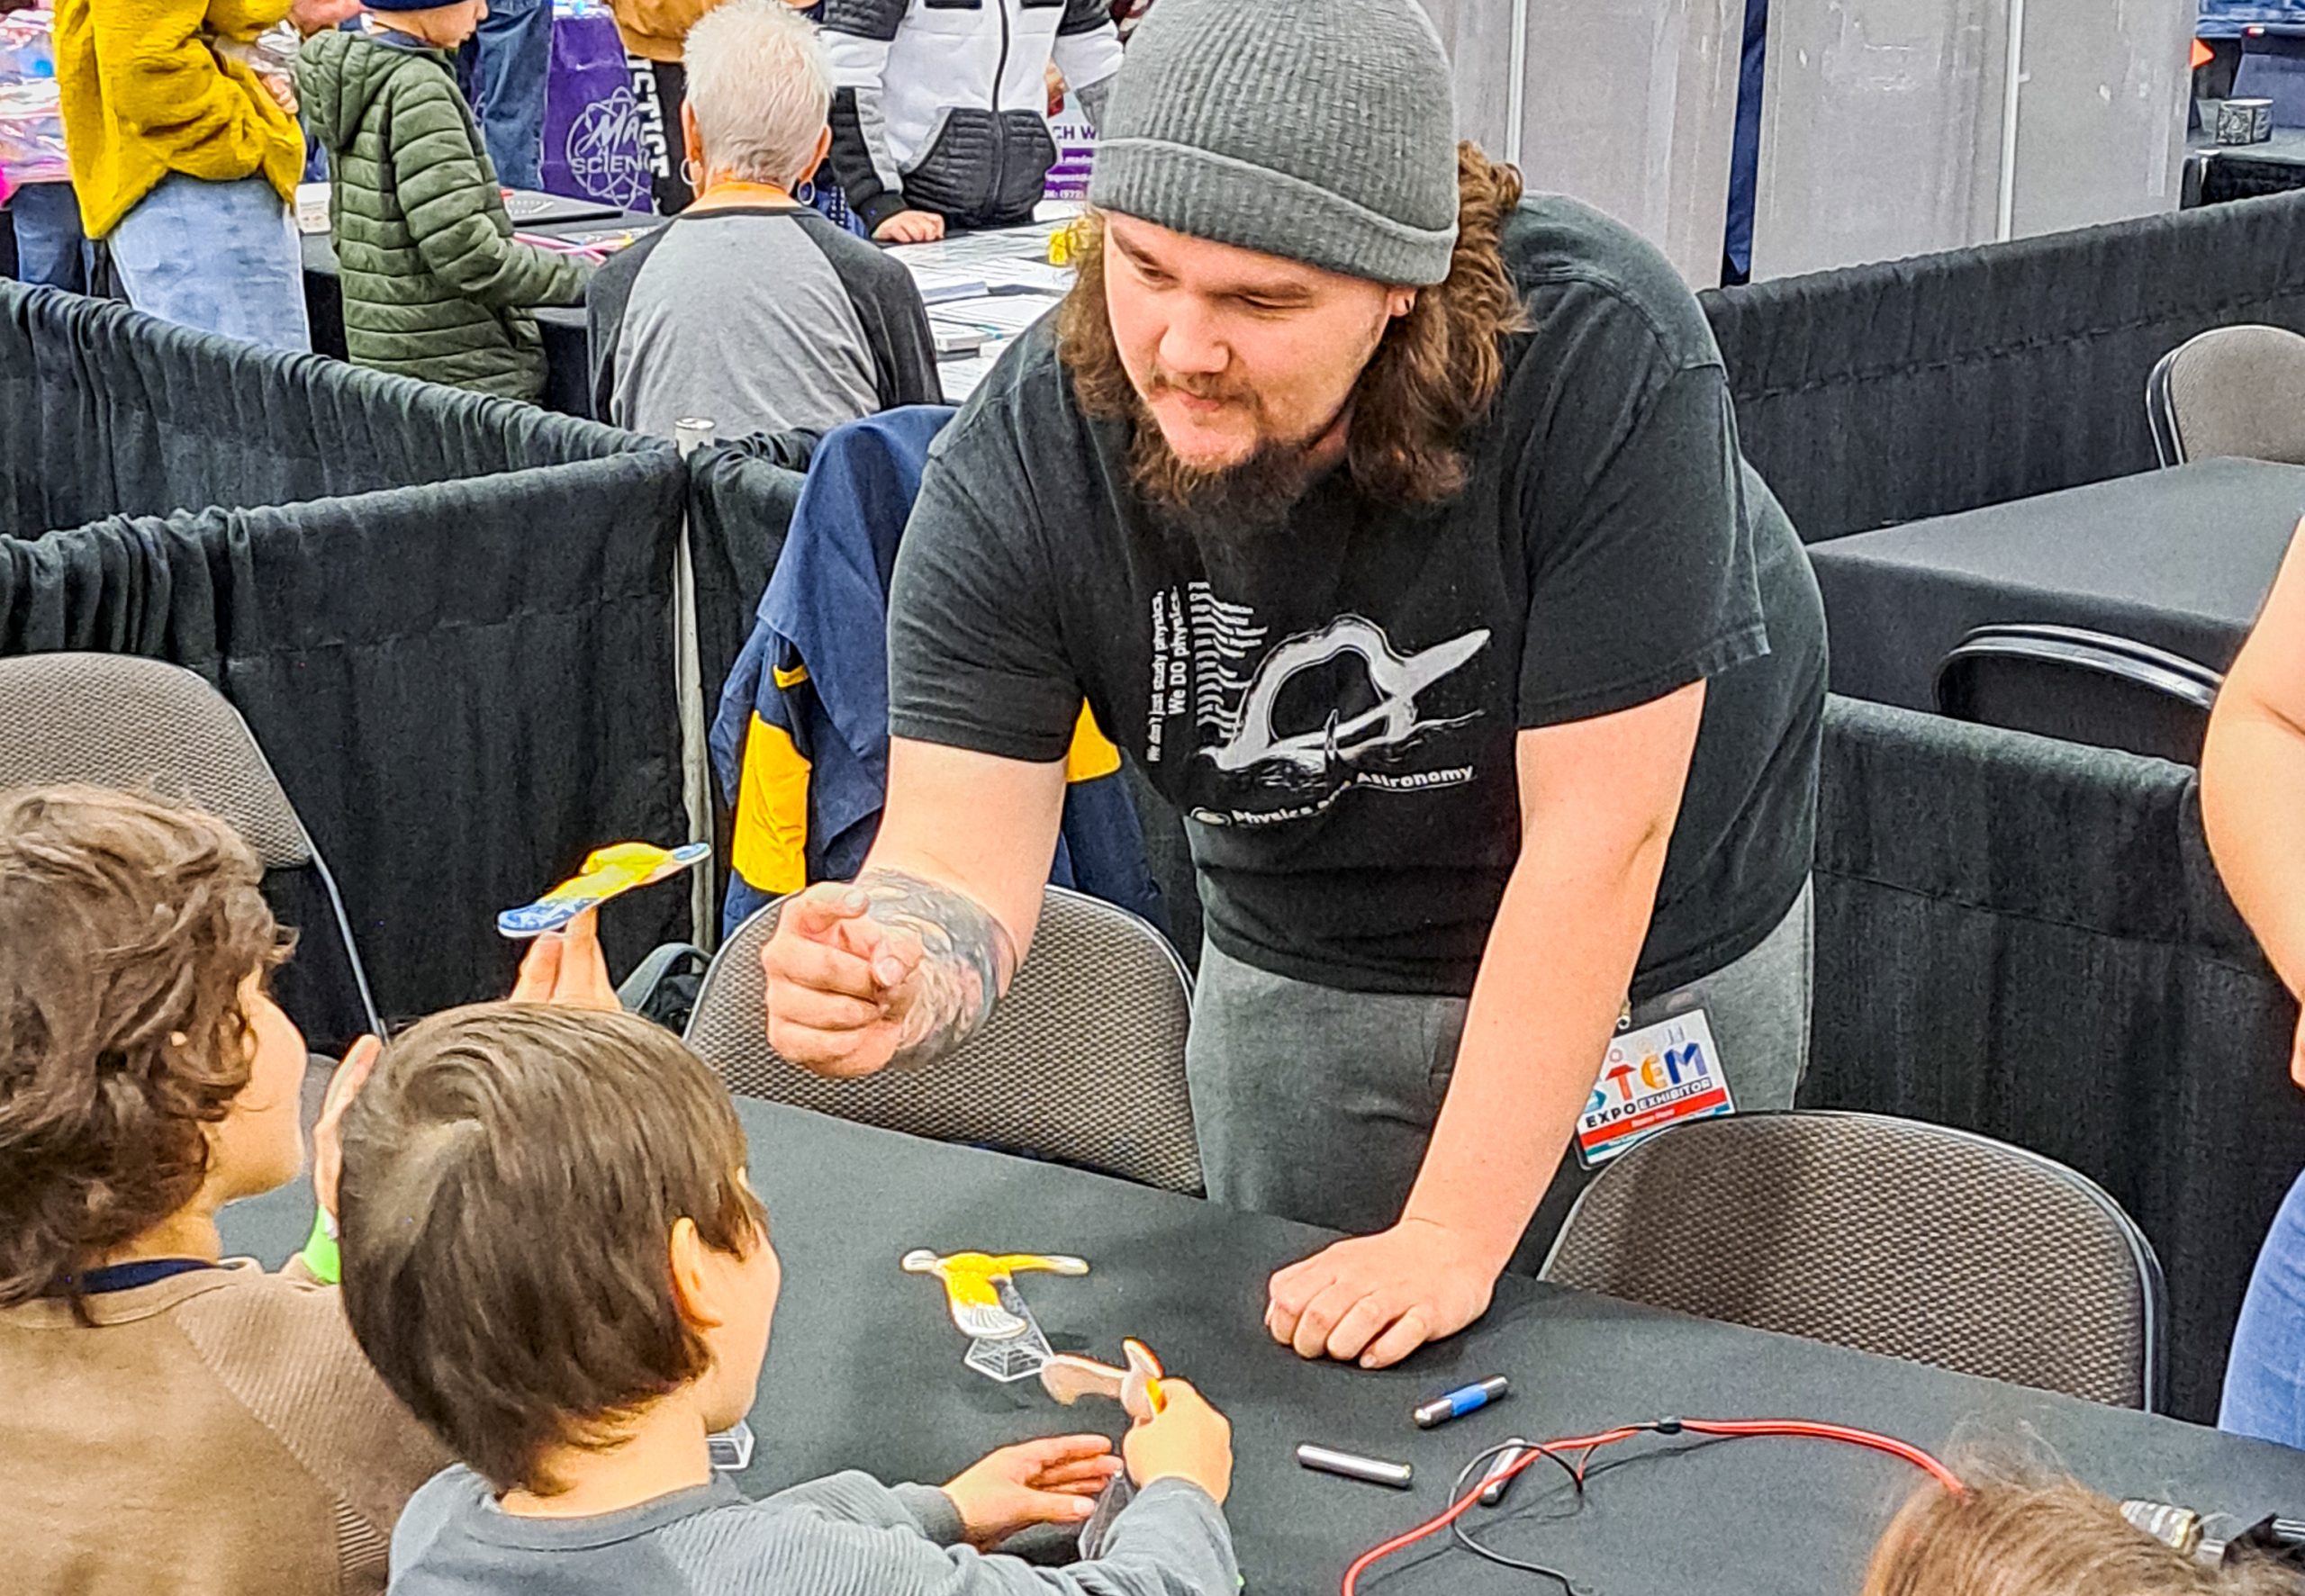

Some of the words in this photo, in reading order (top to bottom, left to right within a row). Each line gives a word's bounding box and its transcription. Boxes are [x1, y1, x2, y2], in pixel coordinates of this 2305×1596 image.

[1170, 661, 1188, 686] DO
[1168, 689, 1187, 715] We
[1585, 1102, 1637, 1129] EXPO
[1637, 1078, 1713, 1111] EXHIBITOR
